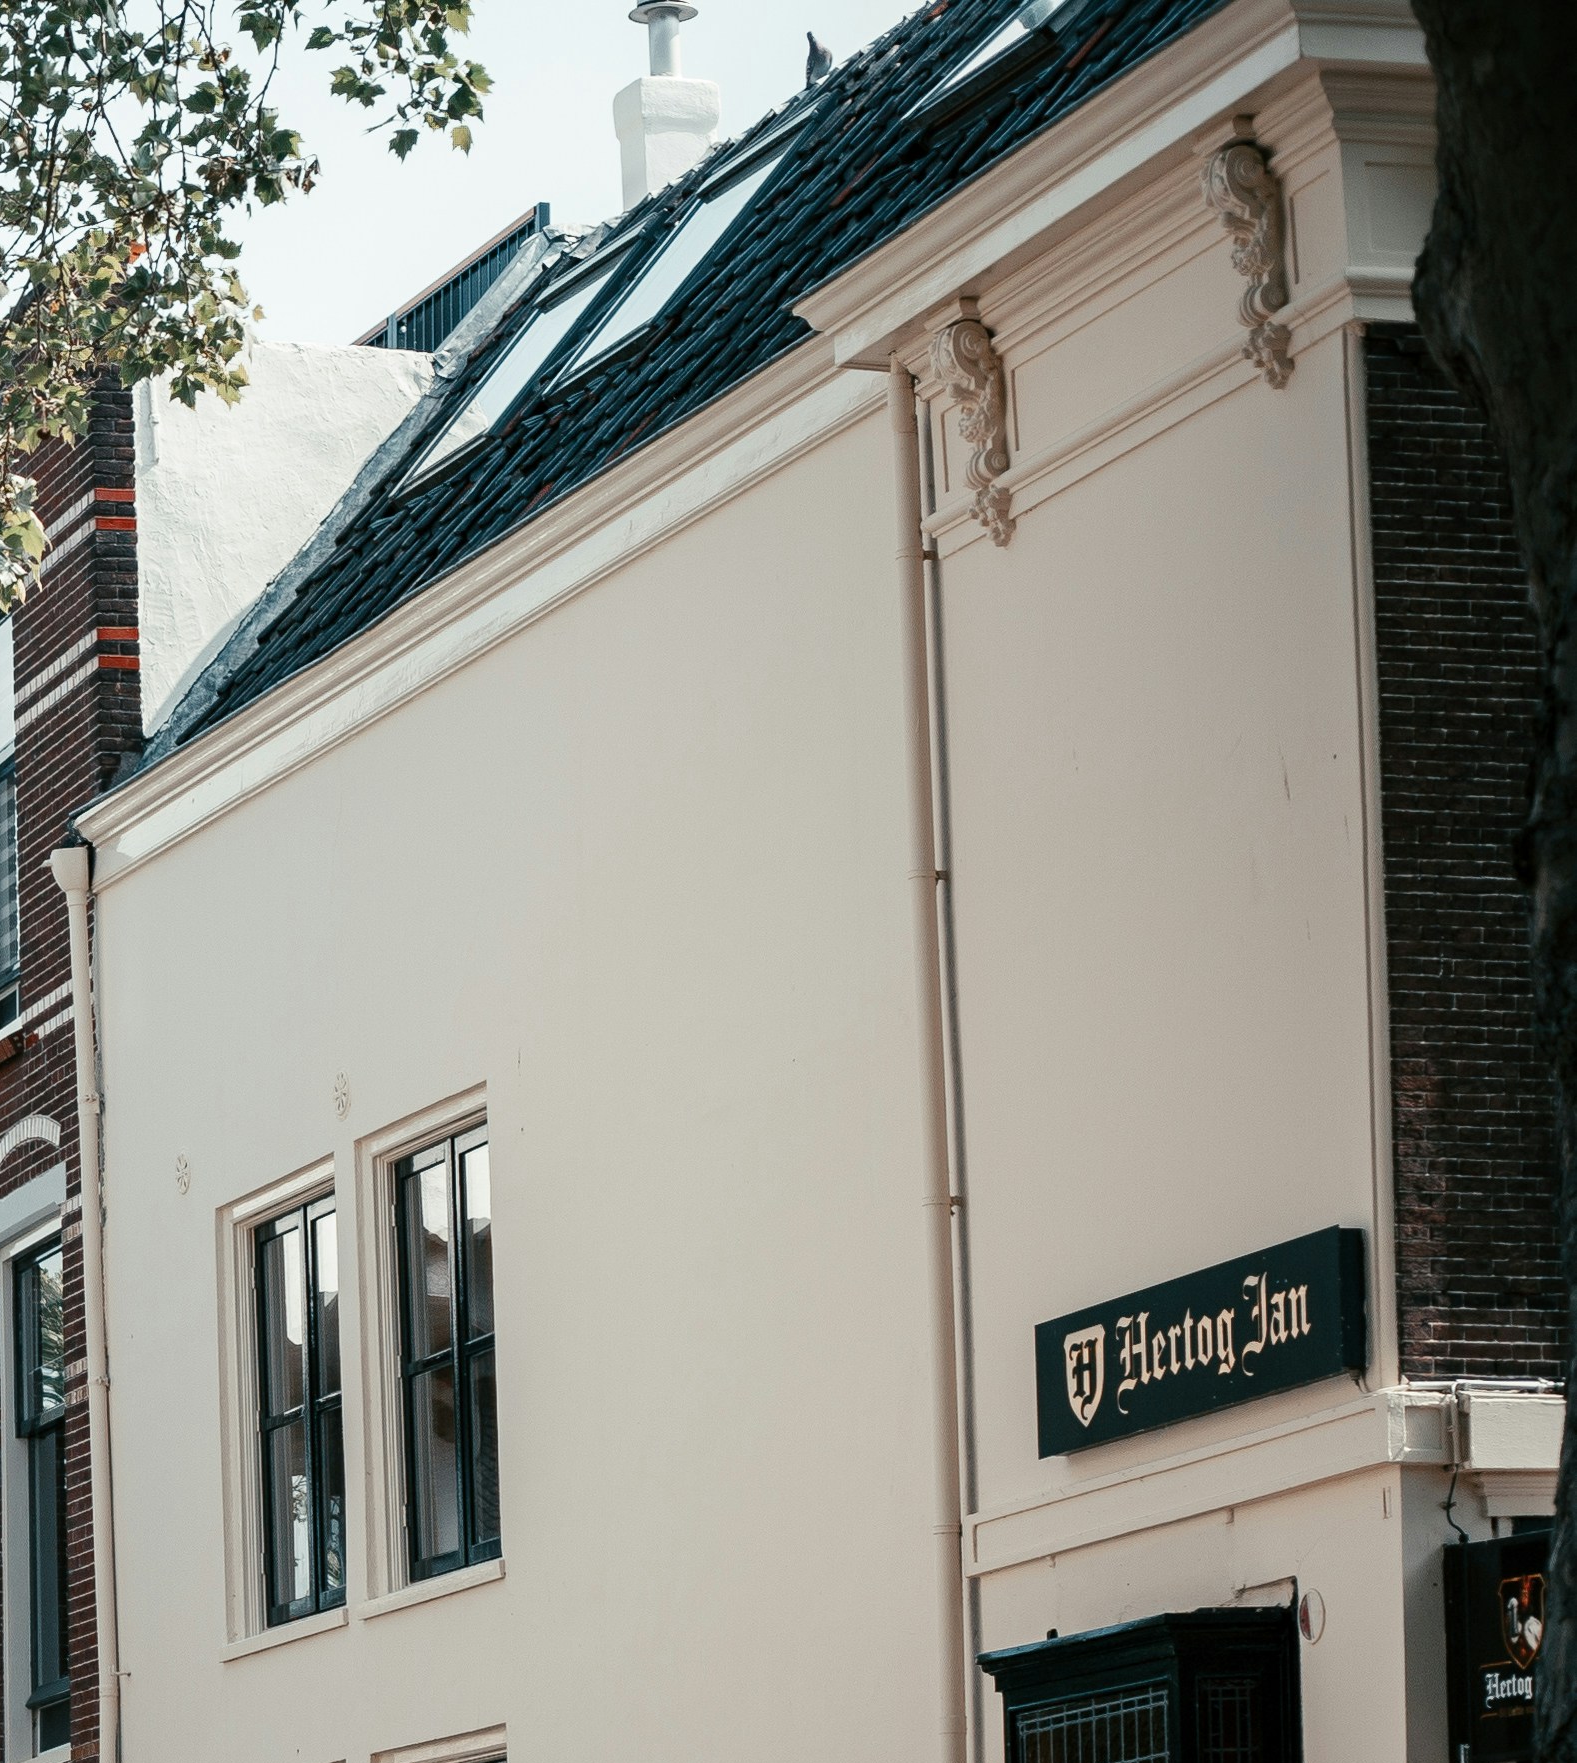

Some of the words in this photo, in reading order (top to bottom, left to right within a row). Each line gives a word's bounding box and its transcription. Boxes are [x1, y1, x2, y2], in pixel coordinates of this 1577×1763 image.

[1115, 1307, 1236, 1415] Hertog
[1242, 1271, 1312, 1377] Jan
[1484, 1671, 1533, 1709] Hertog
